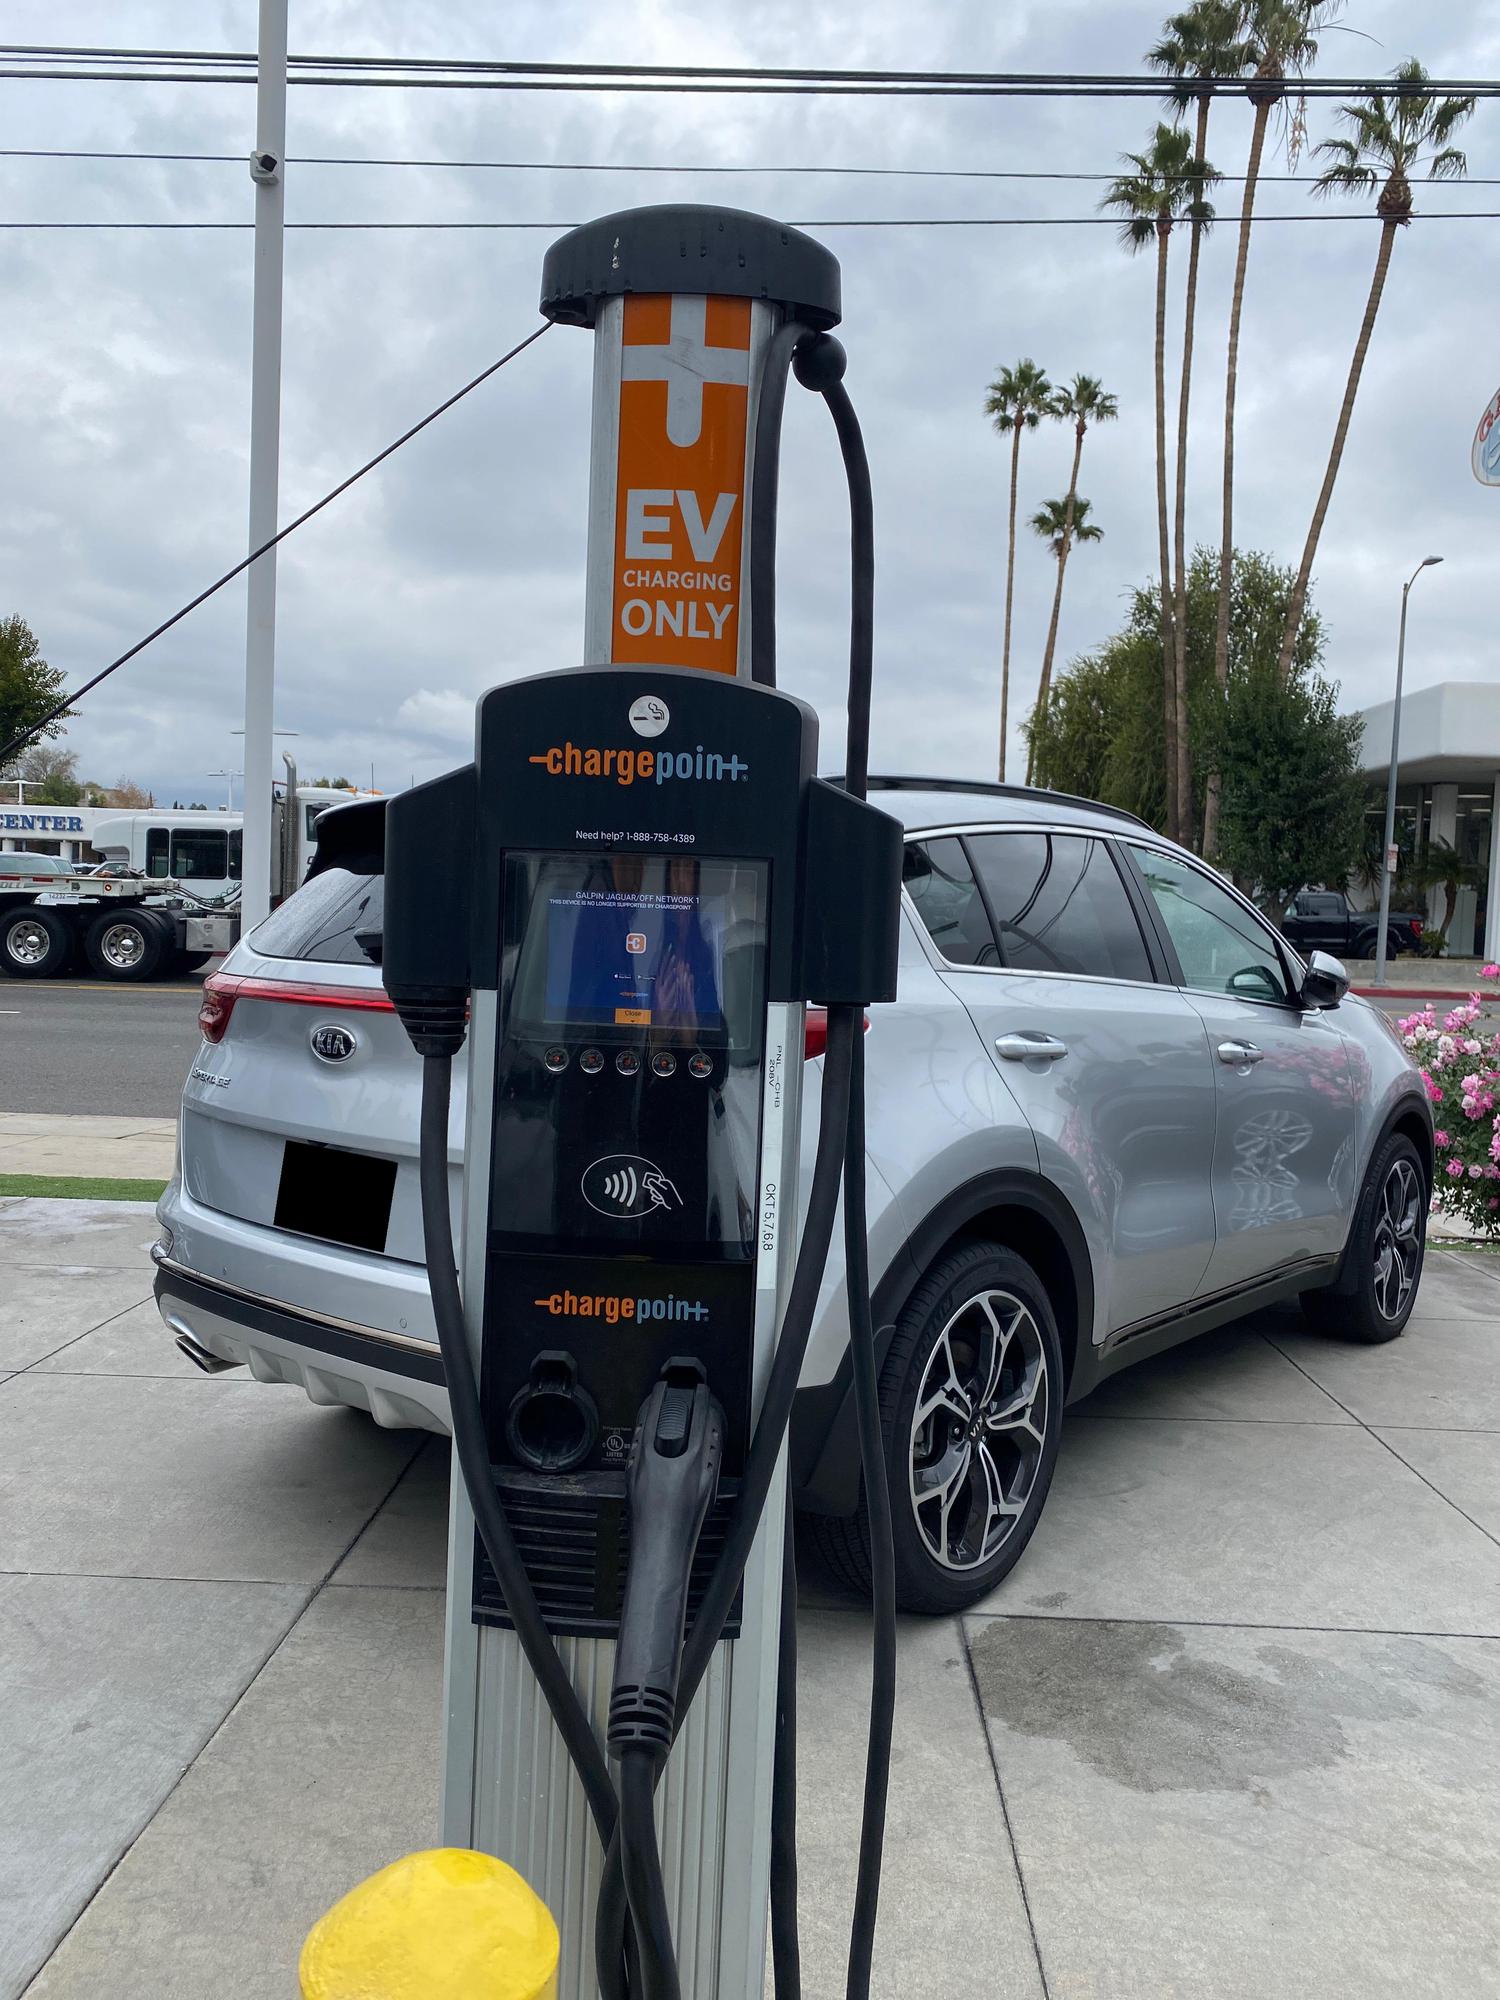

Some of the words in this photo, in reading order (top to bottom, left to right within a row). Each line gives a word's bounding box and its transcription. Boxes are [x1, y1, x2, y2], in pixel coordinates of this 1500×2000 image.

[625, 488, 738, 562] EV
[623, 569, 732, 592] CHARGING
[621, 599, 735, 640] ONLY
[0, 813, 83, 832] ENTER
[576, 830, 599, 840] Need
[601, 831, 624, 841] help?
[626, 832, 695, 843] 1-888-758-4389
[575, 891, 605, 900] GALPIN
[606, 893, 654, 902] JAGUAR/OFF
[656, 895, 694, 904] NETWORK
[316, 1032, 346, 1056] KIA
[765, 1183, 776, 1208] CKT
[762, 1212, 775, 1251] 5,7,6,8
